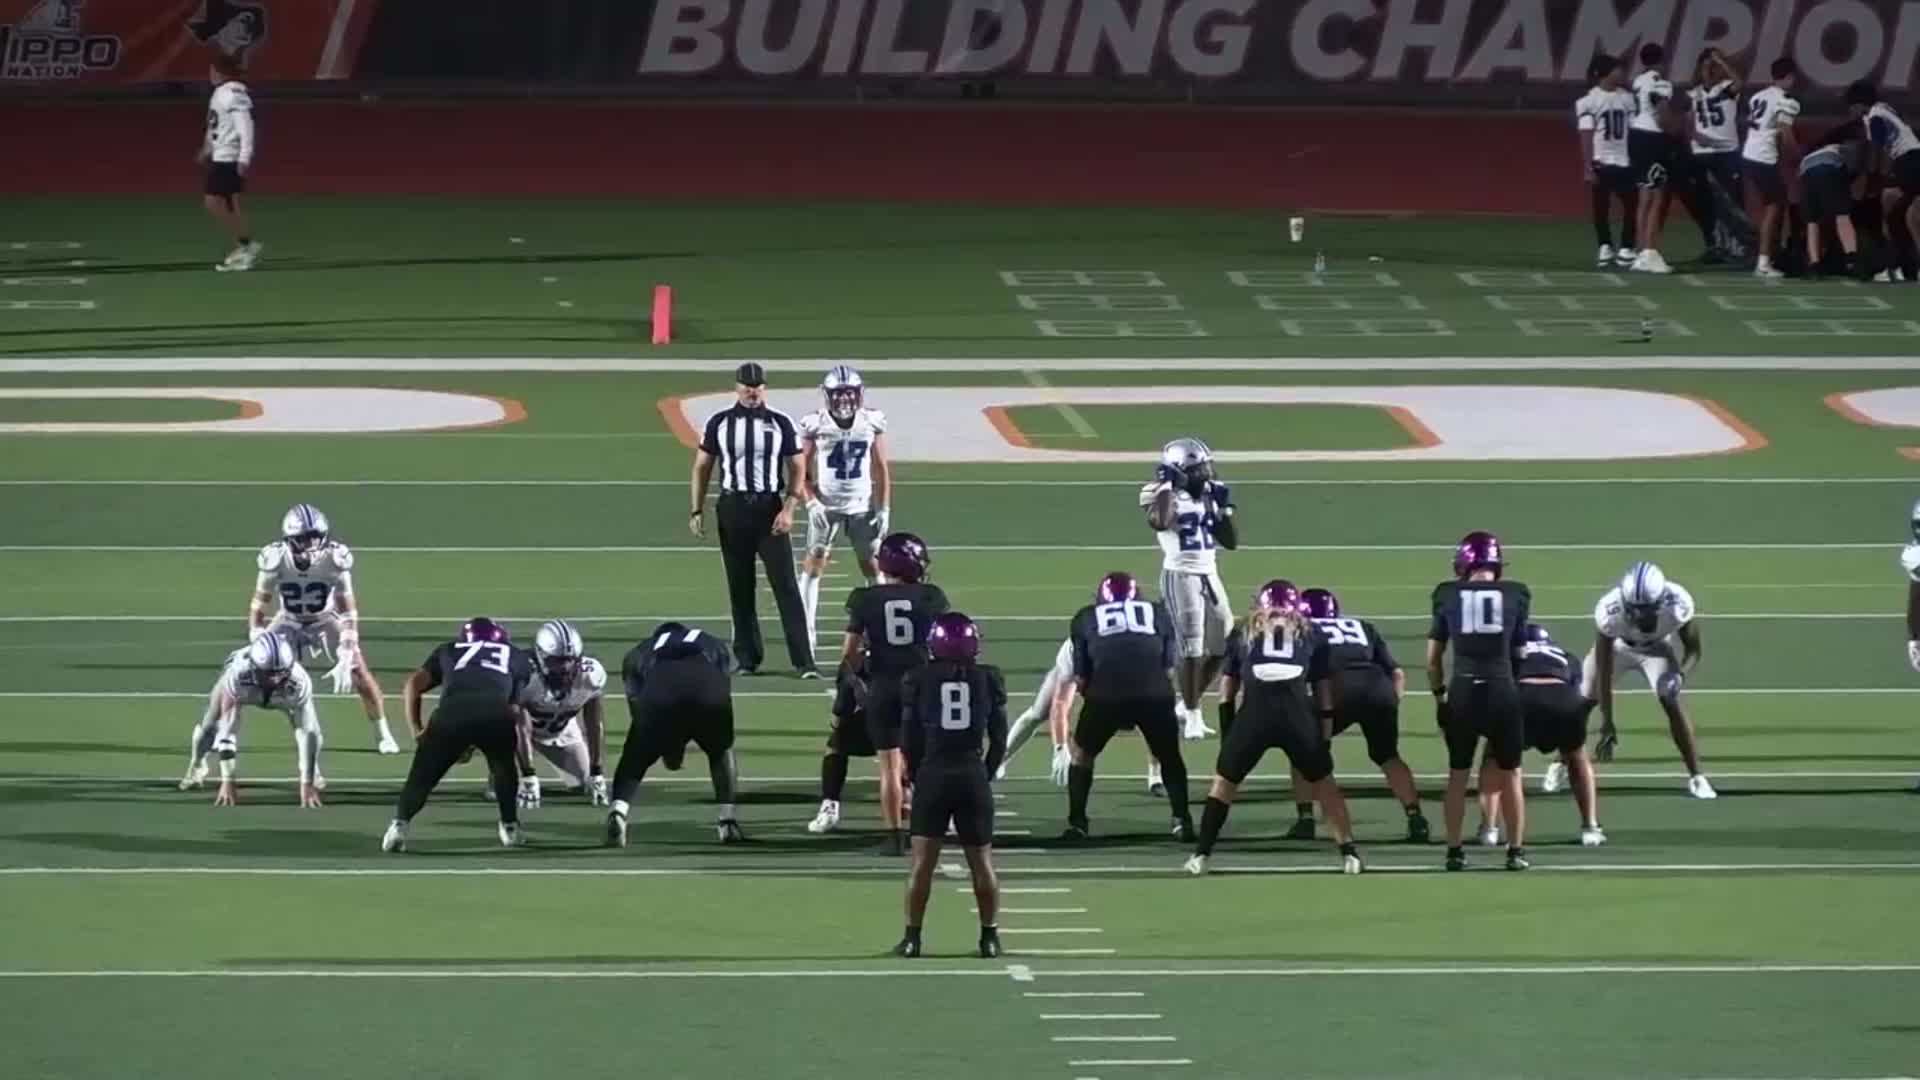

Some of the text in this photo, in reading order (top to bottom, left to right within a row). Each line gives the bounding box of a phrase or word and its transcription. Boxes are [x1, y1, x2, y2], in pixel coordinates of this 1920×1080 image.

[638, 0, 1253, 76] BUILDING
[7, 65, 79, 77] NATION
[1600, 109, 1626, 141] 10
[1695, 100, 1726, 129] 45
[826, 440, 869, 480] 47
[279, 582, 329, 614] 23
[1460, 590, 1503, 634] 10
[884, 599, 915, 645] 6
[1095, 600, 1156, 636] 60
[1310, 617, 1369, 646] 59
[454, 640, 511, 674] 73
[1262, 620, 1294, 658] 0
[940, 681, 972, 730] 8
